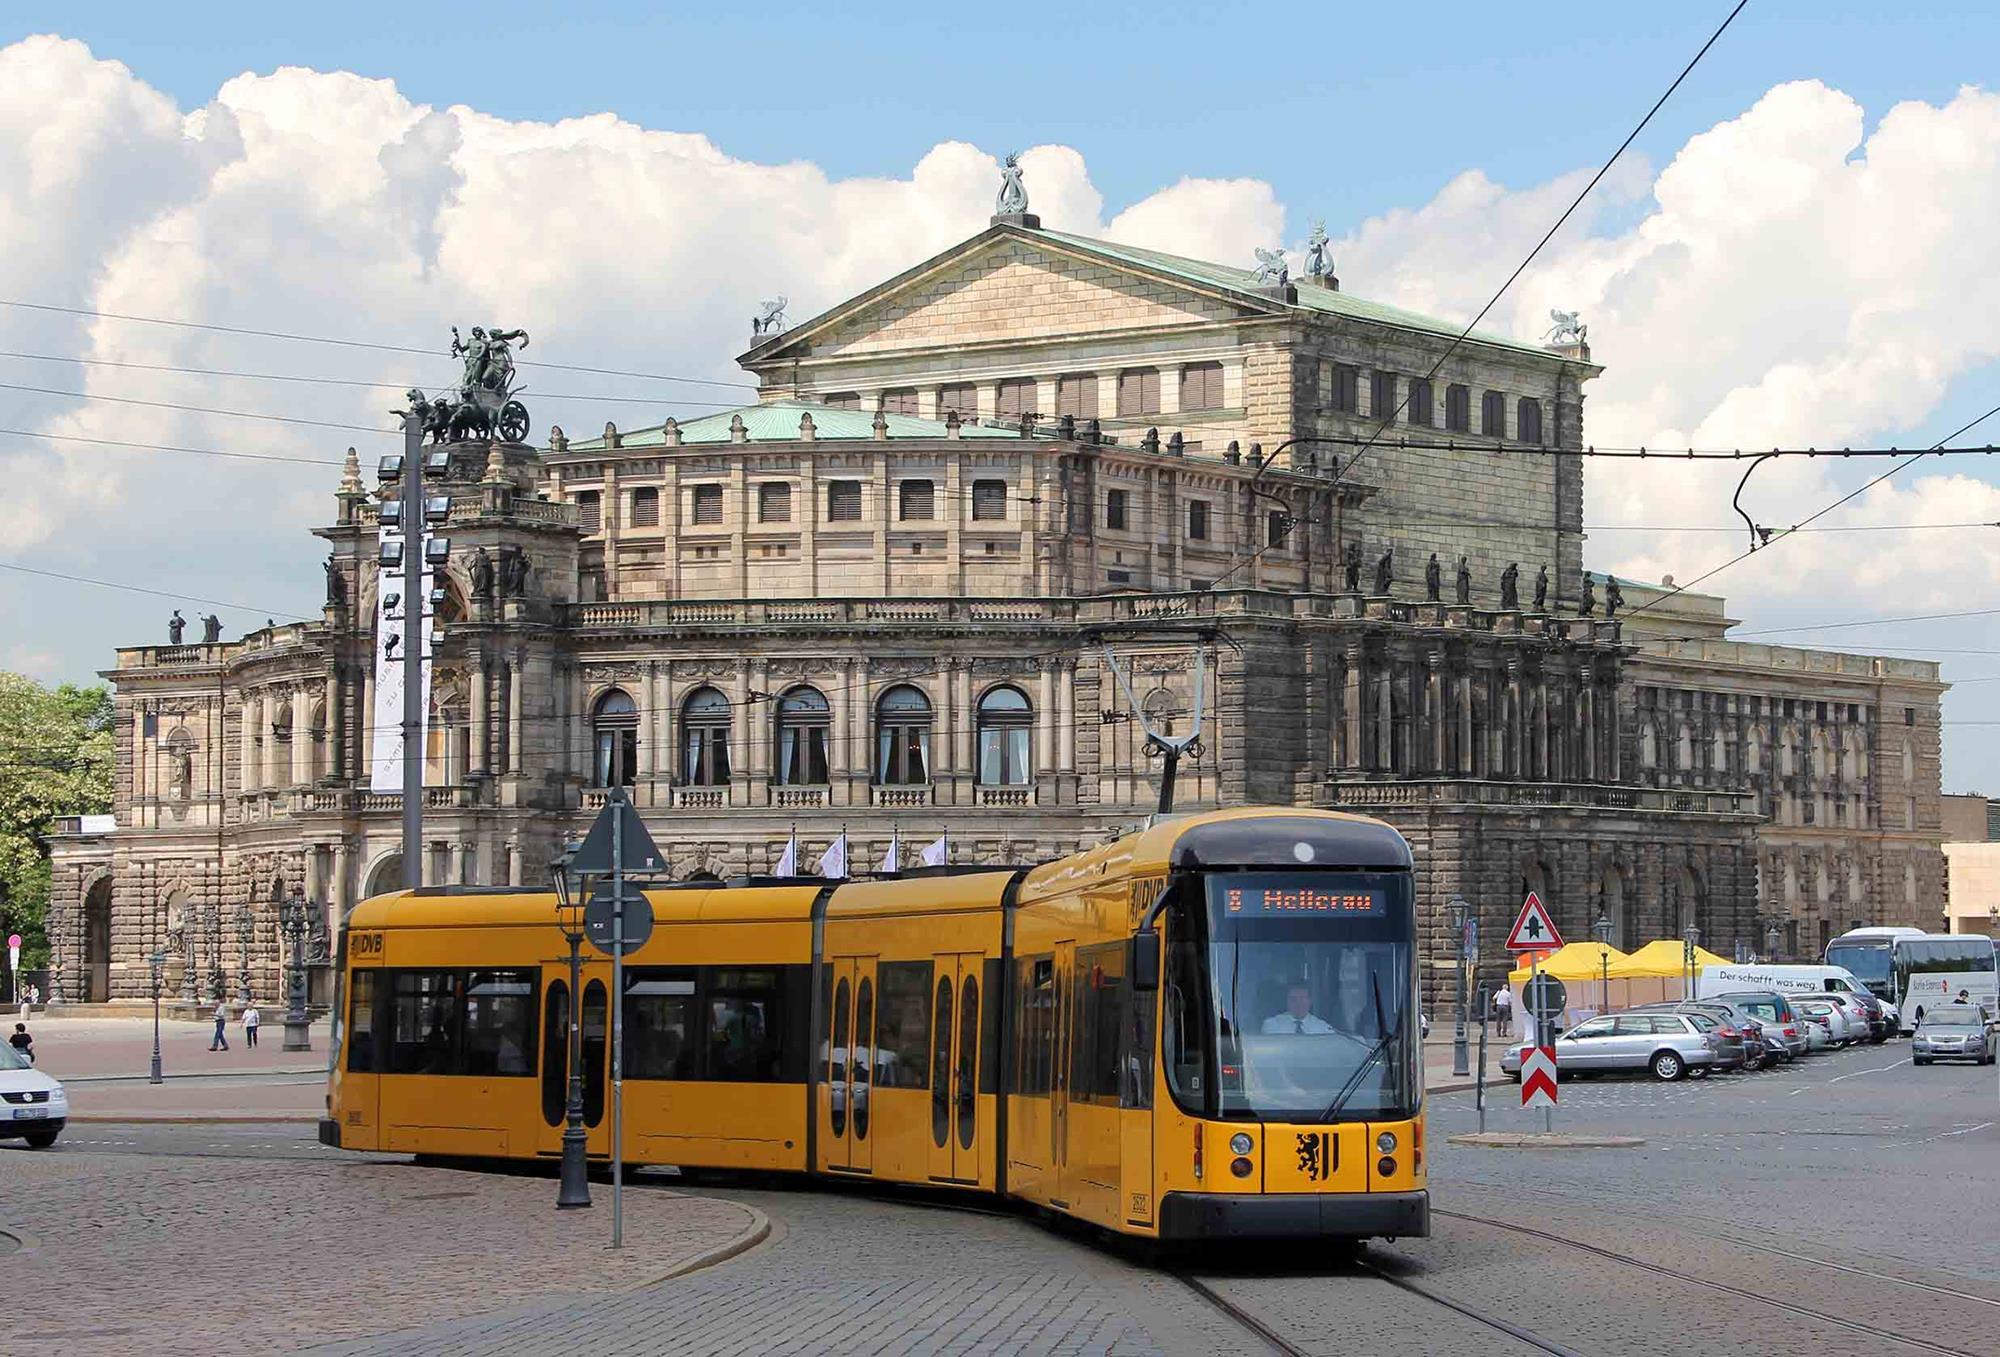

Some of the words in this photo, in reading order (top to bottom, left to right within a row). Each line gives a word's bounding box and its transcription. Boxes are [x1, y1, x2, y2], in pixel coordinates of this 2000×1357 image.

[361, 934, 383, 953] DVB
[1720, 970, 1736, 980] Der
[1738, 973, 1772, 985] schafft
[1776, 978, 1794, 988] was
